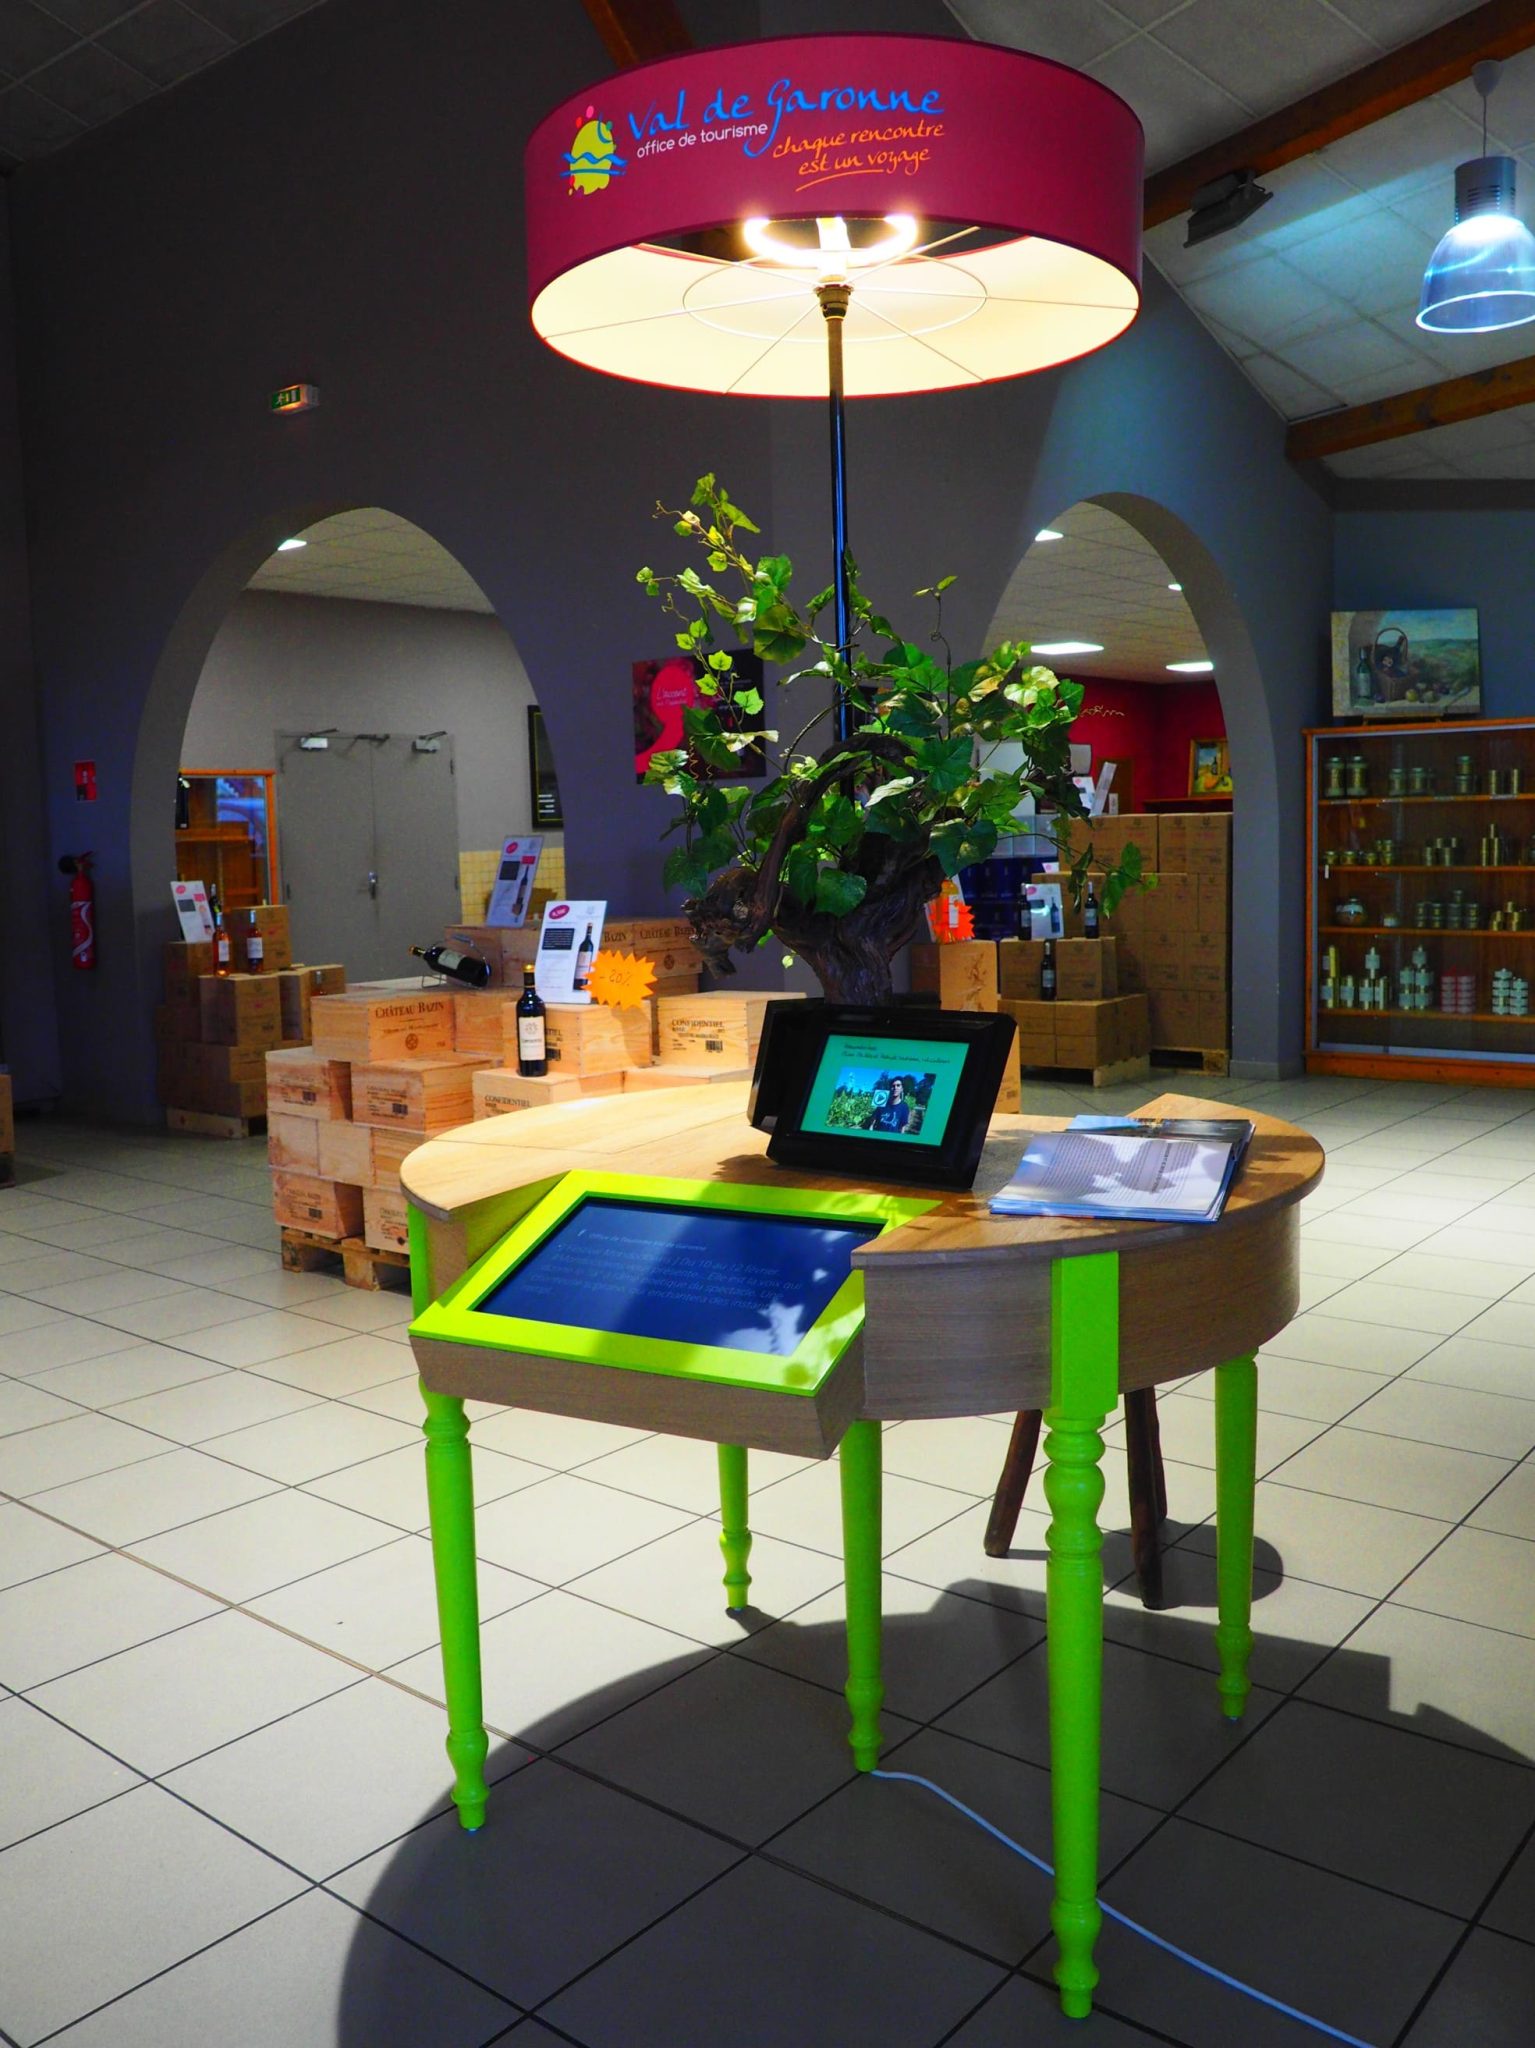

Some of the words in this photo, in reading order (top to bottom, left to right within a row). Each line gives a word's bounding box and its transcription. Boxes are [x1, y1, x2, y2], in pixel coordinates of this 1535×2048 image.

[629, 90, 690, 140] Val
[703, 88, 754, 124] de
[743, 78, 945, 158] Garonne
[636, 134, 675, 158] office
[678, 132, 697, 148] de
[700, 123, 768, 144] tourisme
[772, 131, 847, 159] chaque
[849, 119, 946, 145] rencontre
[797, 158, 829, 176] est
[834, 155, 865, 169] un
[867, 147, 932, 176] voyage
[375, 1002, 415, 1019] CHÂTEAU
[418, 1000, 445, 1013] BAZIN
